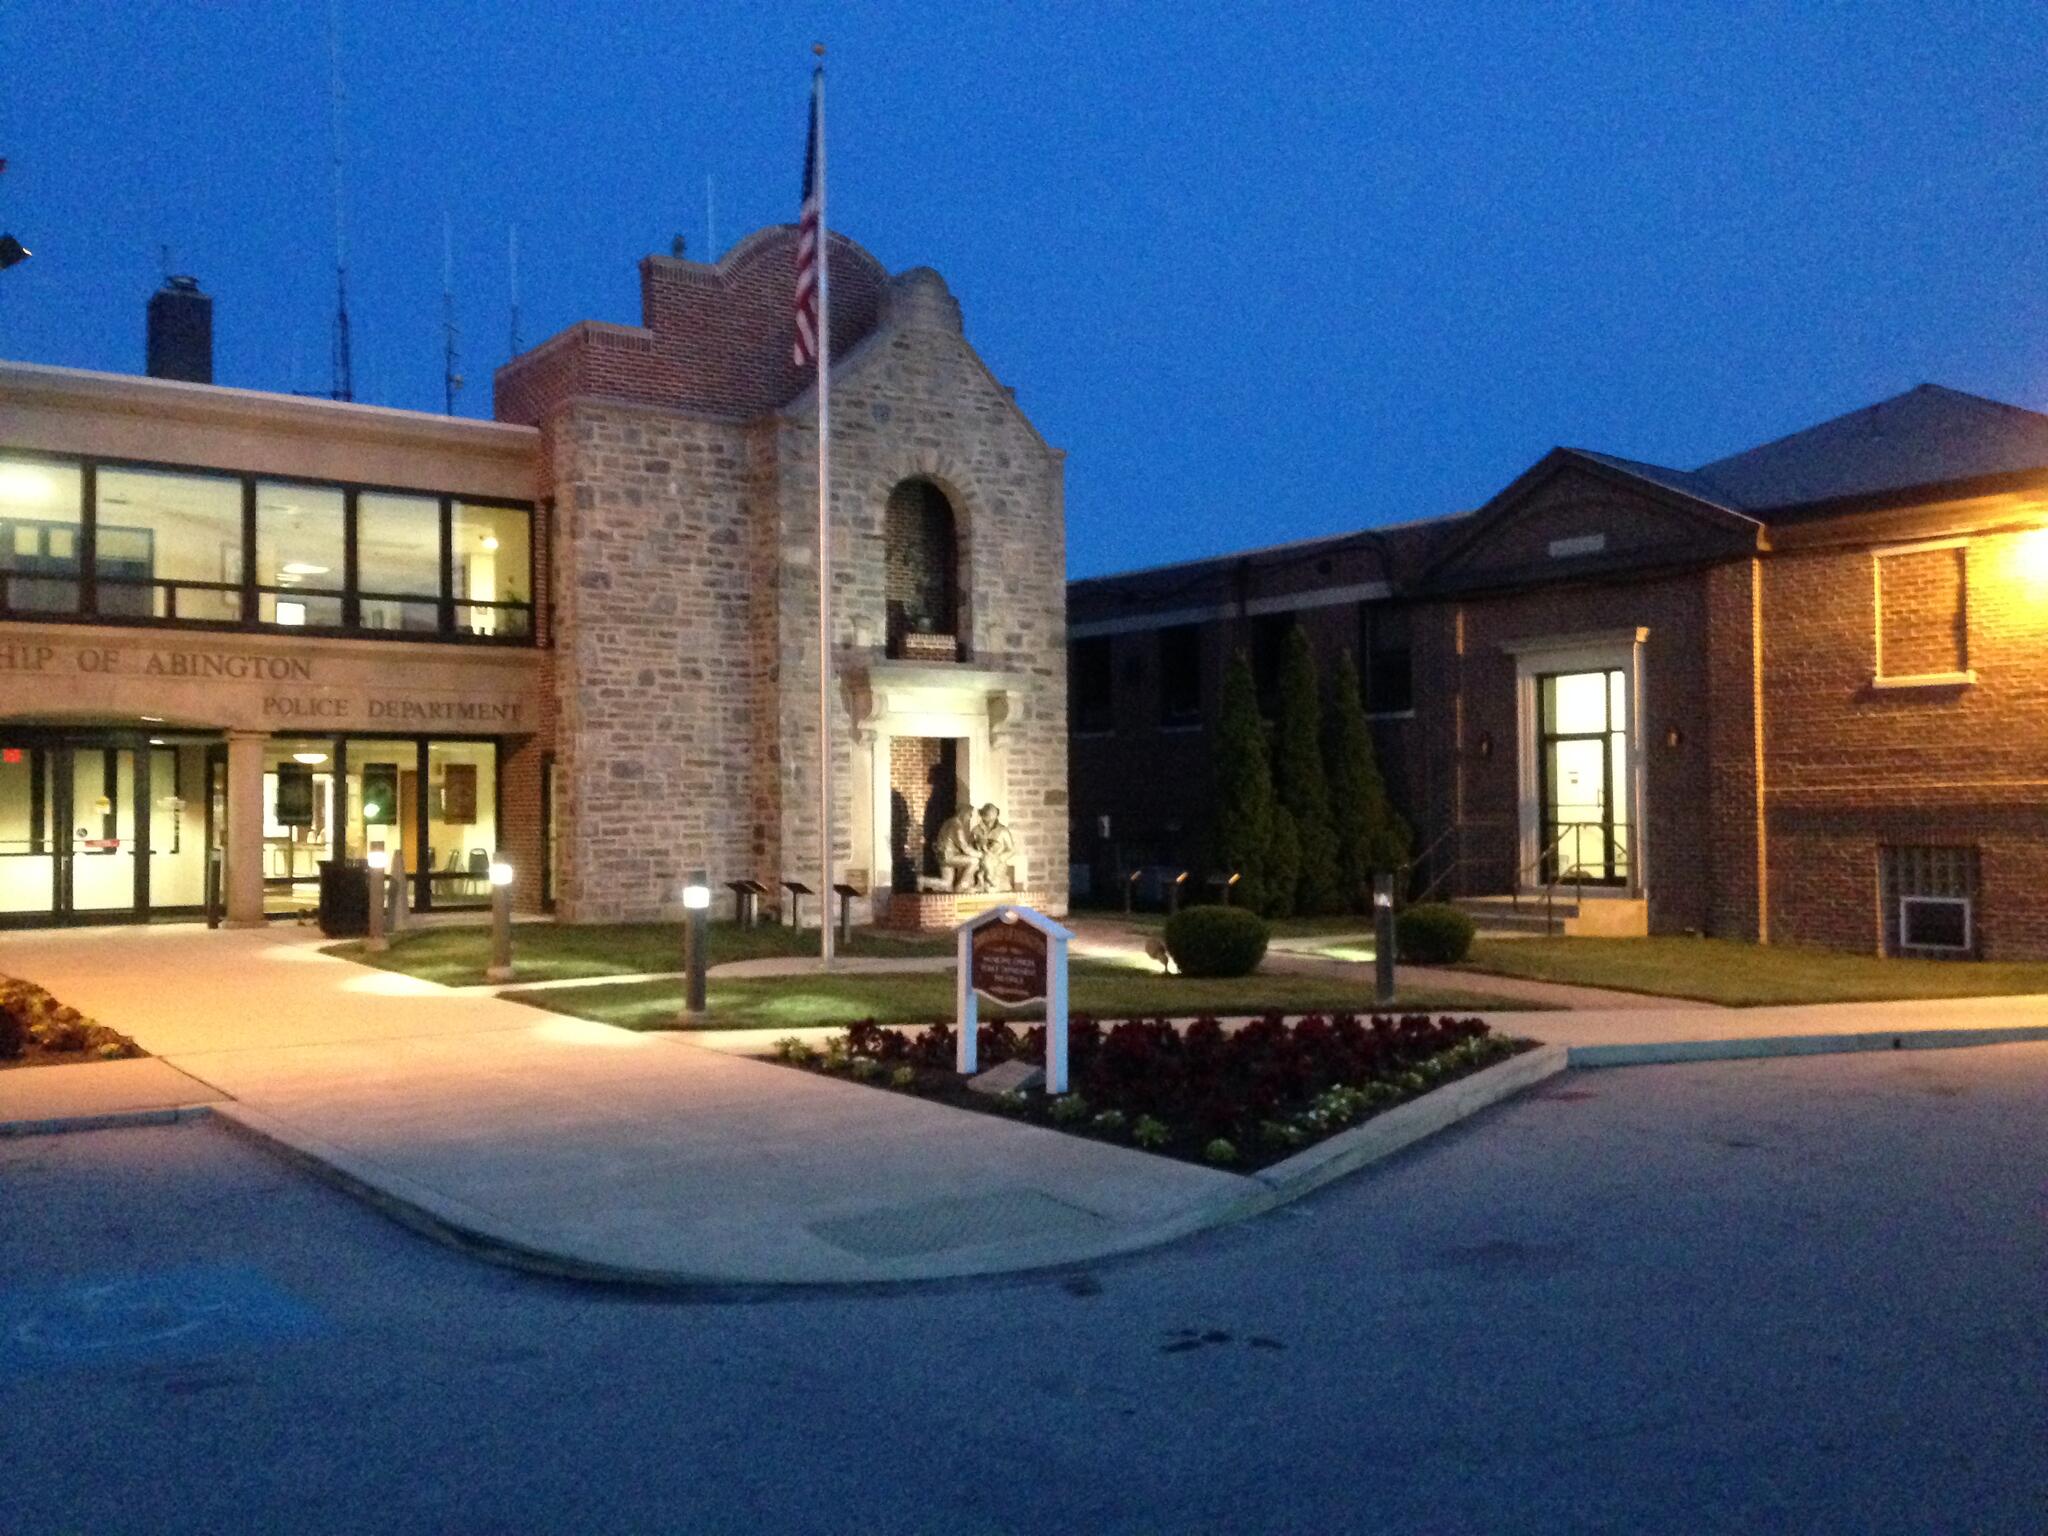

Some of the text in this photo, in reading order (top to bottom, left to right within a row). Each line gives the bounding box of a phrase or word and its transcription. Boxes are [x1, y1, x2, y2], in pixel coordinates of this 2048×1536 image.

[77, 648, 120, 673] OF
[143, 651, 313, 680] ABINGTON
[263, 697, 521, 721] POLICE DEPARTMENT
